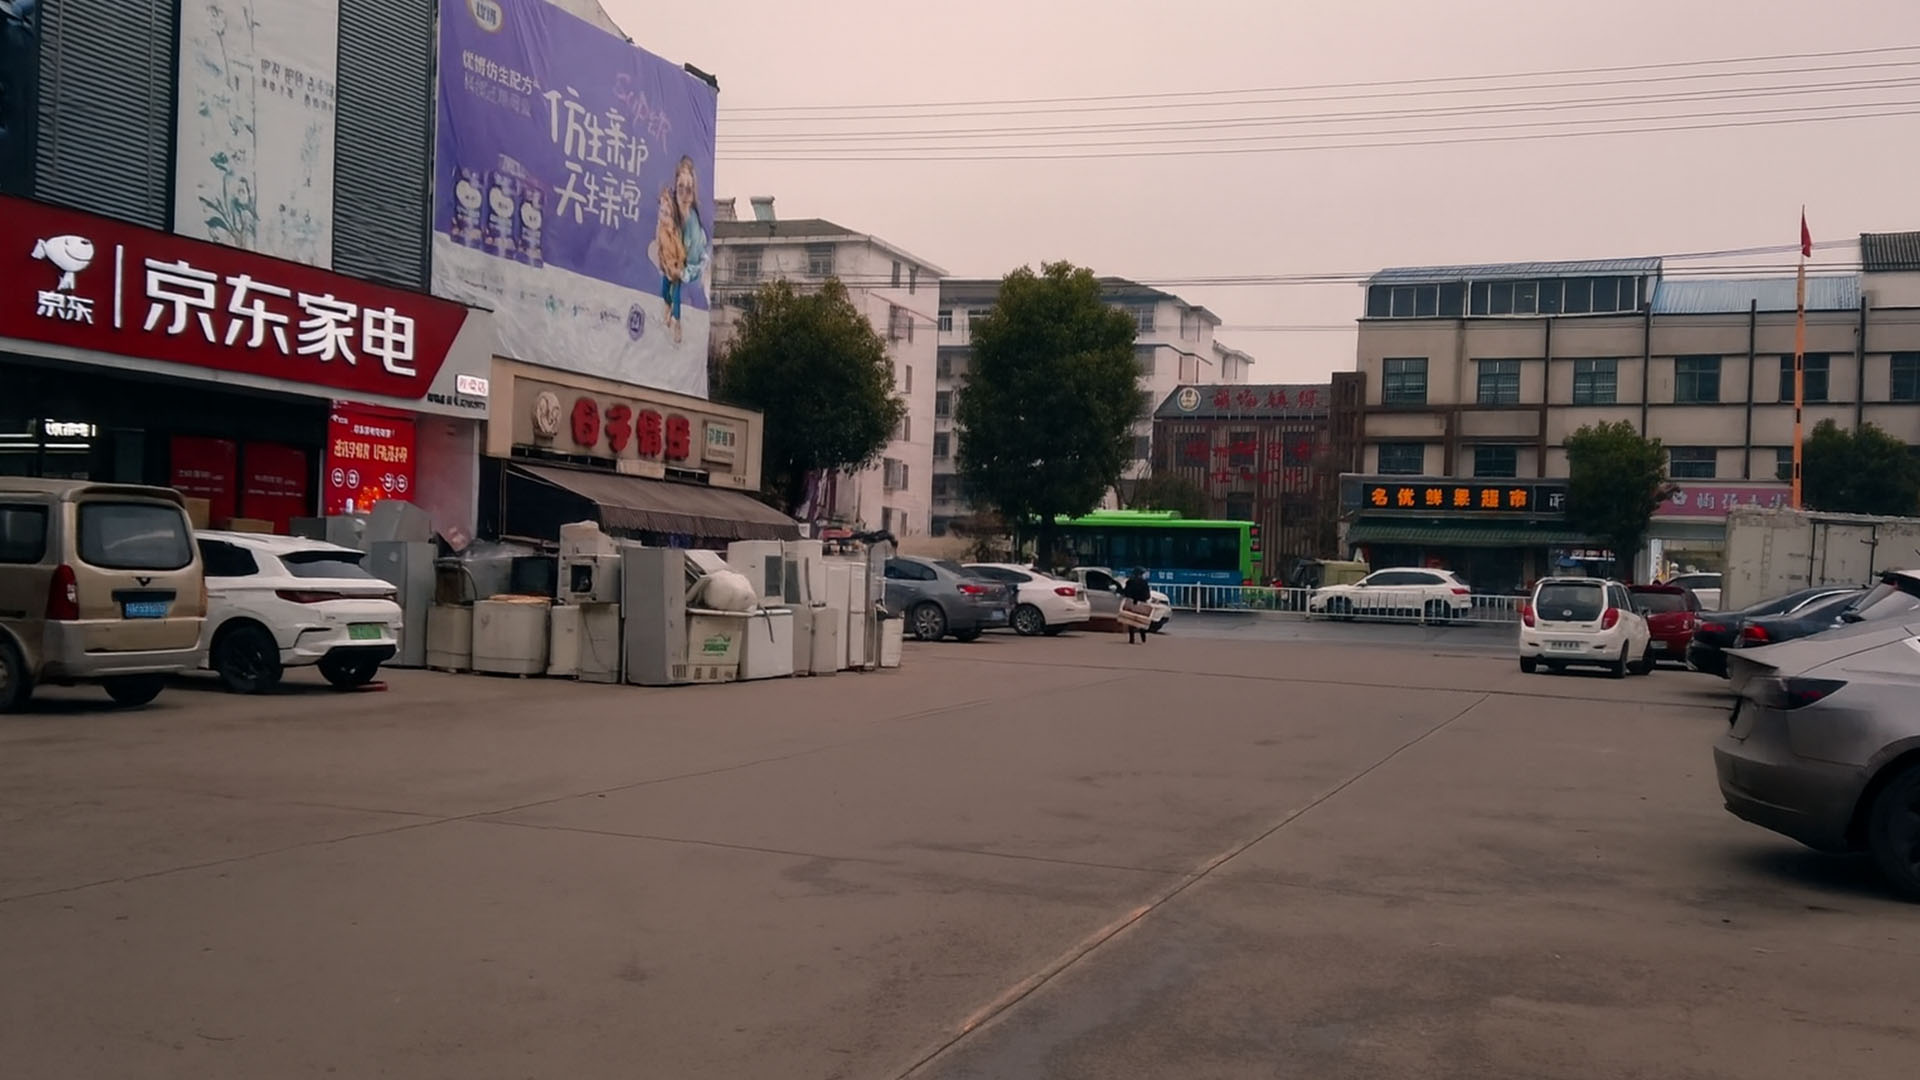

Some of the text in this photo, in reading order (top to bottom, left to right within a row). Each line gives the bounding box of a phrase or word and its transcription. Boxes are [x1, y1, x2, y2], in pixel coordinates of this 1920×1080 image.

[543, 86, 649, 177] 仿生亲护
[553, 160, 641, 230] 天生亲密
[36, 289, 95, 325] 京东
[143, 259, 417, 377] 京东家电
[1371, 487, 1528, 508] 名优鲜果超市
